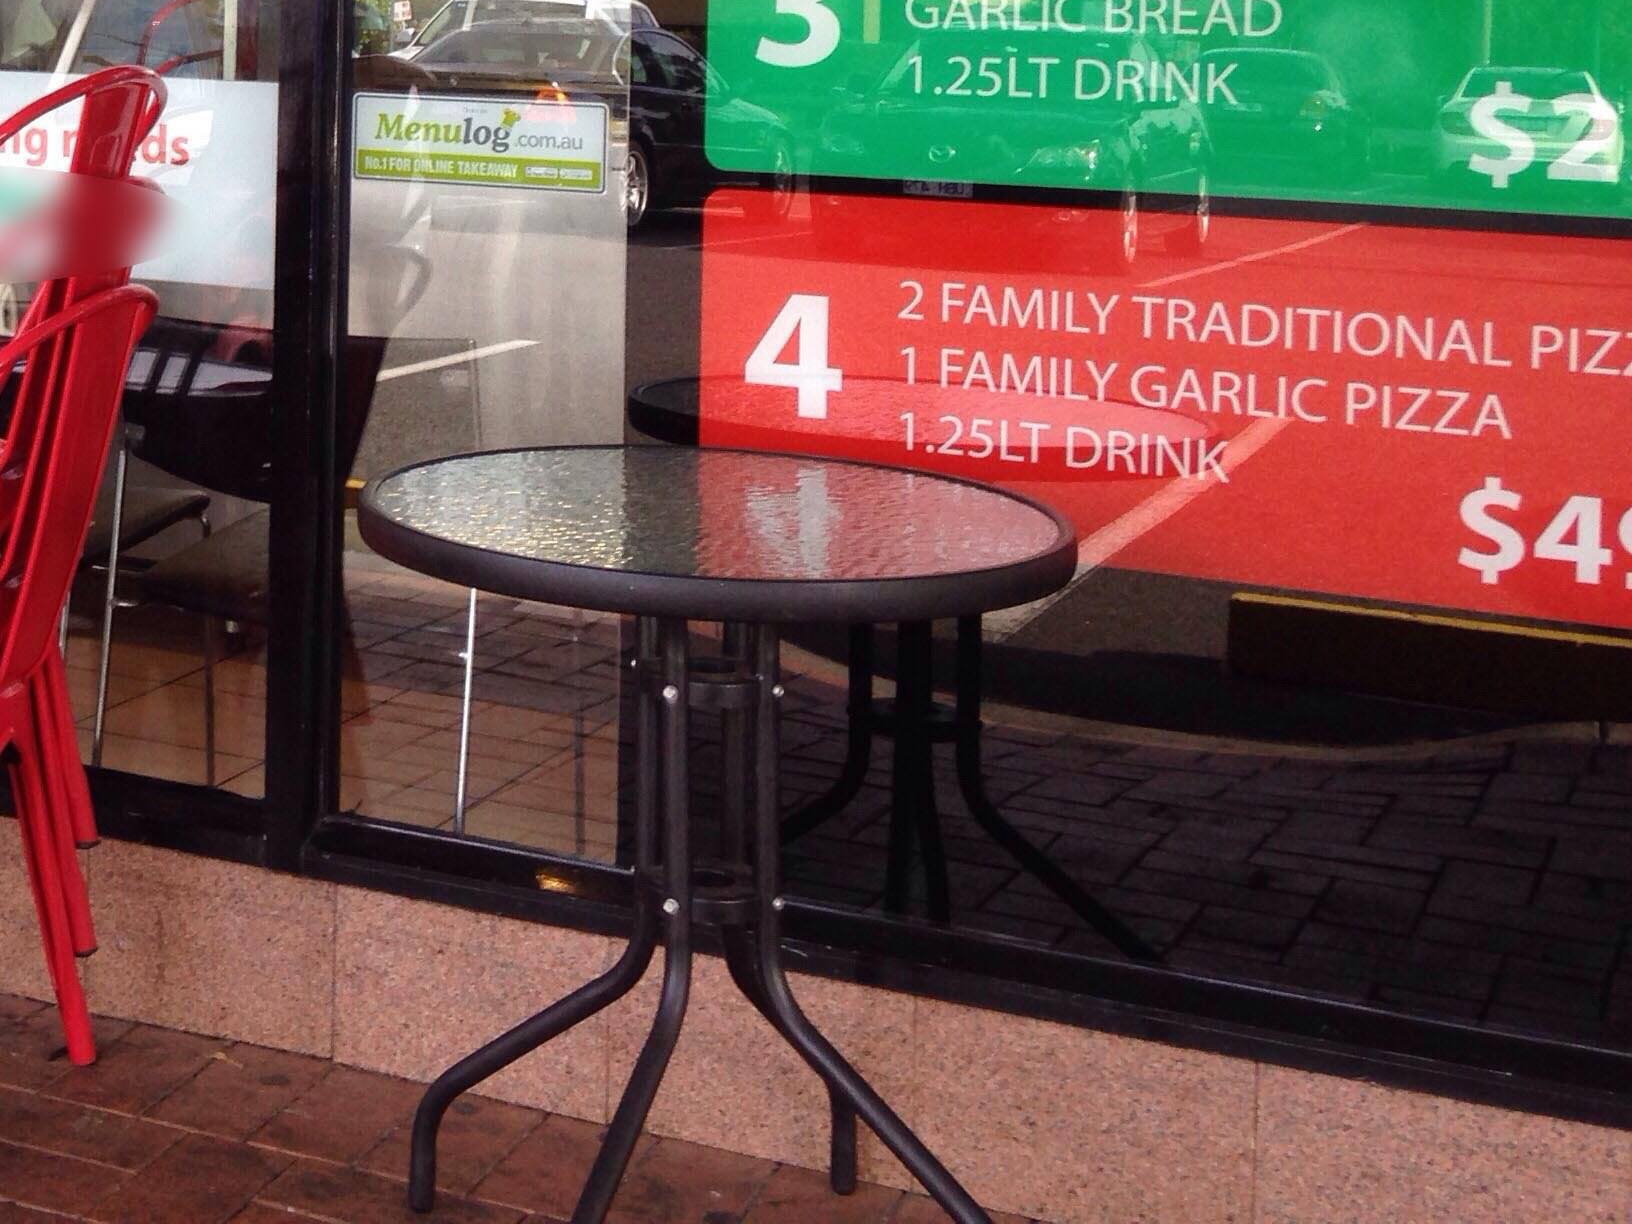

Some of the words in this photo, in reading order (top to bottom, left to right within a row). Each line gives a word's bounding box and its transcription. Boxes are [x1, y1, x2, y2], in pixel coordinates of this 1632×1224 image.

[909, 56, 1059, 99] 1.25LT
[1076, 60, 1240, 107] DRINK
[63, 123, 190, 166] nds
[389, 158, 411, 172] FOR
[414, 159, 454, 174] ONLINE
[457, 161, 518, 178] TAKEAWAY
[744, 294, 842, 419] 4
[898, 281, 926, 320] 2
[941, 284, 1120, 336] FAMILY
[1132, 296, 1512, 368] TRADITIONAL
[1531, 325, 1632, 376] PIZ
[902, 347, 917, 384] 1
[940, 347, 1120, 402] FAMILY
[1130, 362, 1327, 422] GARLIC
[1345, 383, 1512, 439] PIZZA
[899, 412, 1051, 466] 1.25LT
[1064, 426, 1230, 483] DRINK
